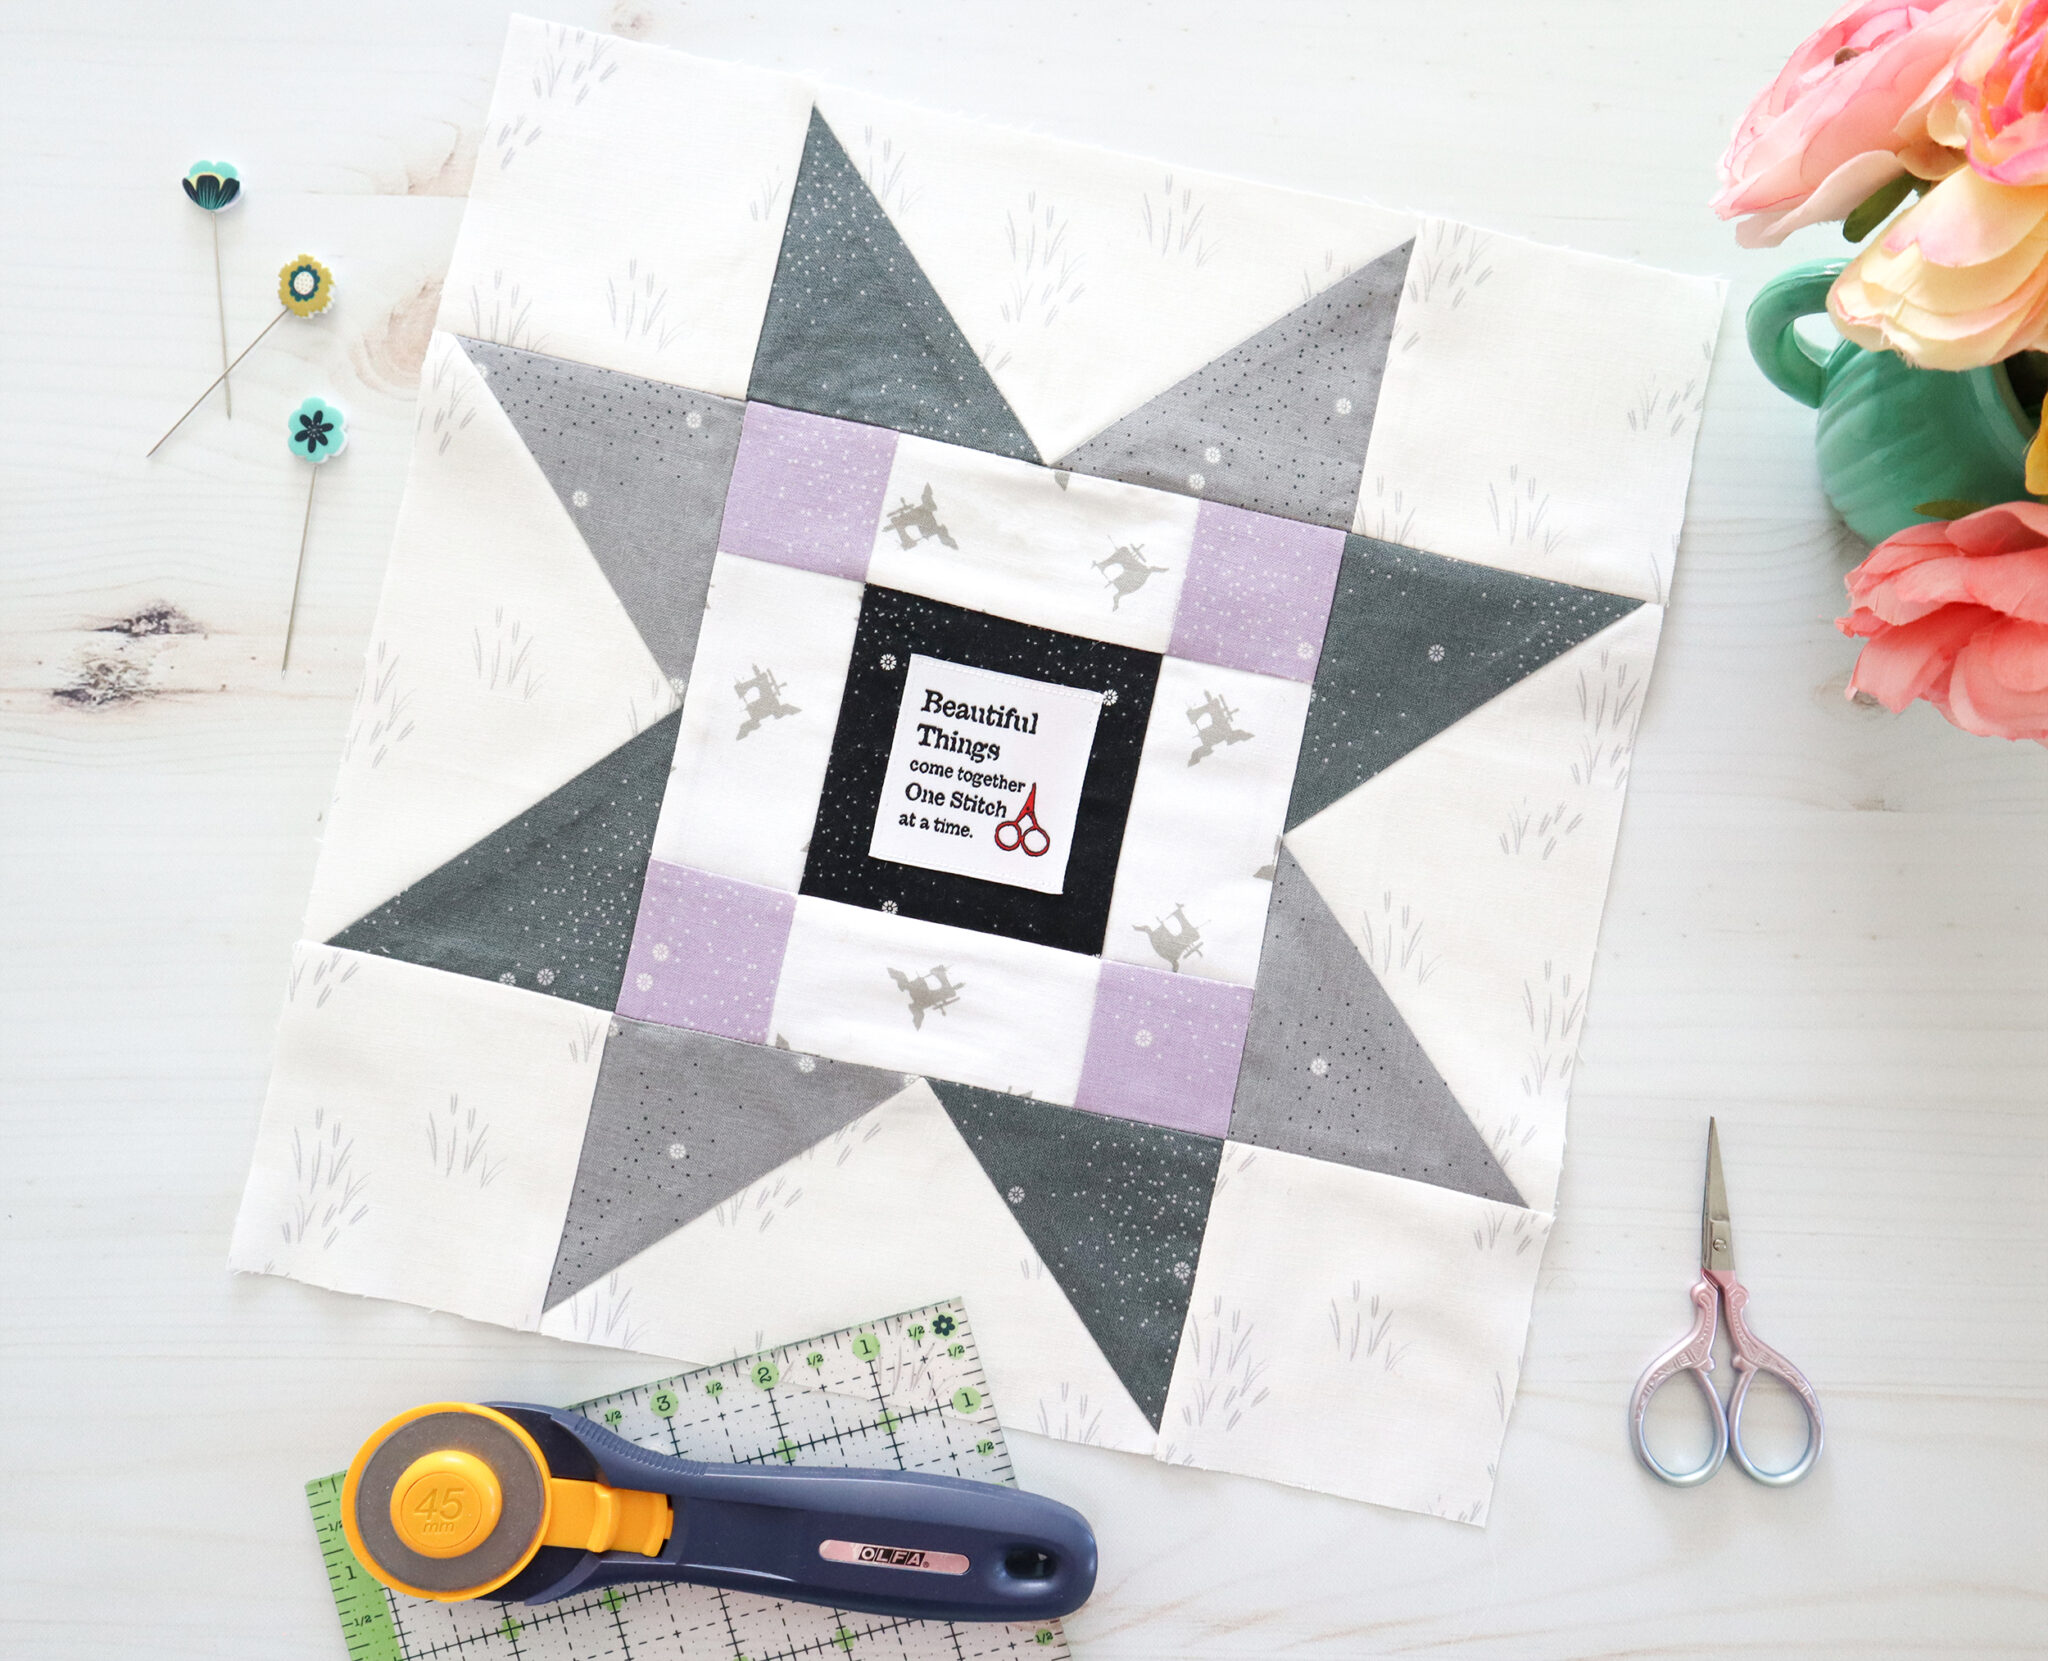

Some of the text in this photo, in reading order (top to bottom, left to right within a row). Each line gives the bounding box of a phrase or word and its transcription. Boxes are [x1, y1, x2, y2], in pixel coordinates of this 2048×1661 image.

[921, 689, 1039, 735] Beautiful
[917, 723, 1001, 763] Things
[910, 759, 1027, 793] come together
[905, 782, 1008, 818] One Stitch
[899, 812, 974, 838] at a time.
[907, 1325, 925, 1338] 1/2
[860, 1339, 872, 1355] 1
[947, 1345, 965, 1357] 1/2
[806, 1353, 824, 1366] 1/2
[757, 1367, 772, 1383] 2
[705, 1382, 723, 1394] 1/2
[657, 1395, 671, 1411] 3
[962, 1392, 974, 1408] 1
[605, 1410, 622, 1422] 1/2
[976, 1441, 994, 1454] 1/2
[414, 1488, 464, 1520] 45
[423, 1522, 455, 1533] mm
[859, 1546, 925, 1567] OLFA
[345, 1565, 357, 1580] 1
[354, 1614, 372, 1626] 1/2
[1035, 1631, 1054, 1644] 1/2
